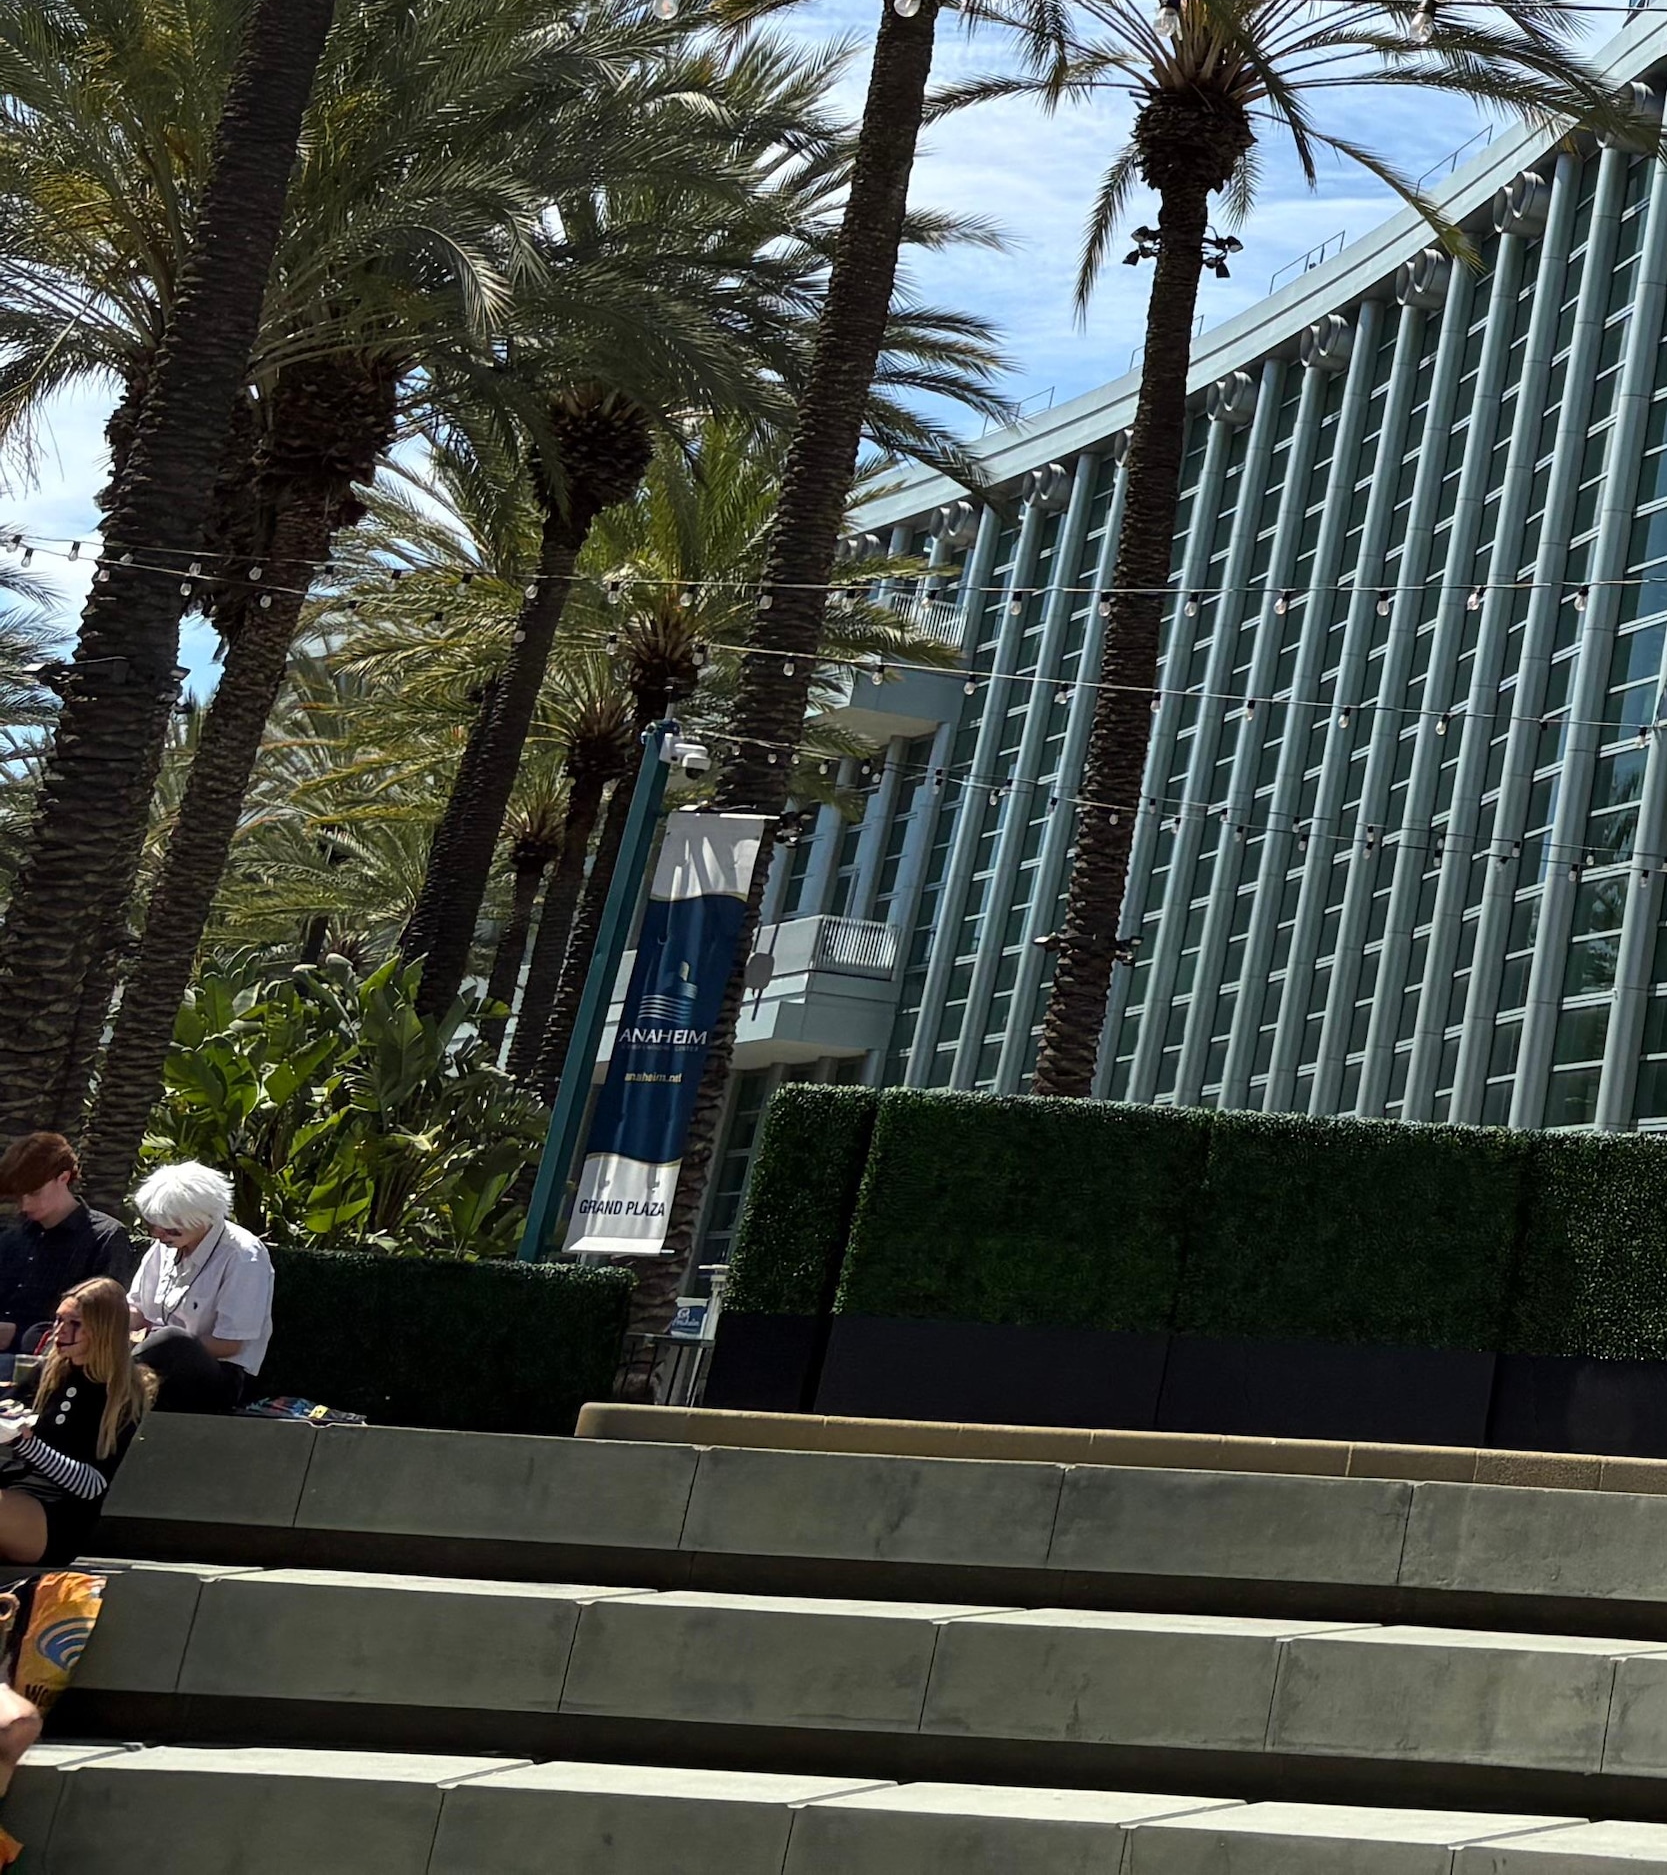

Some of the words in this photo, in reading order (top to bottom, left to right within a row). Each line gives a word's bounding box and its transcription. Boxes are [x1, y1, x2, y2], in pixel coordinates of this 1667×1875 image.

[618, 1027, 708, 1045] ANAHEIM
[579, 1198, 623, 1215] GRAND
[625, 1200, 665, 1217] PLAZA
